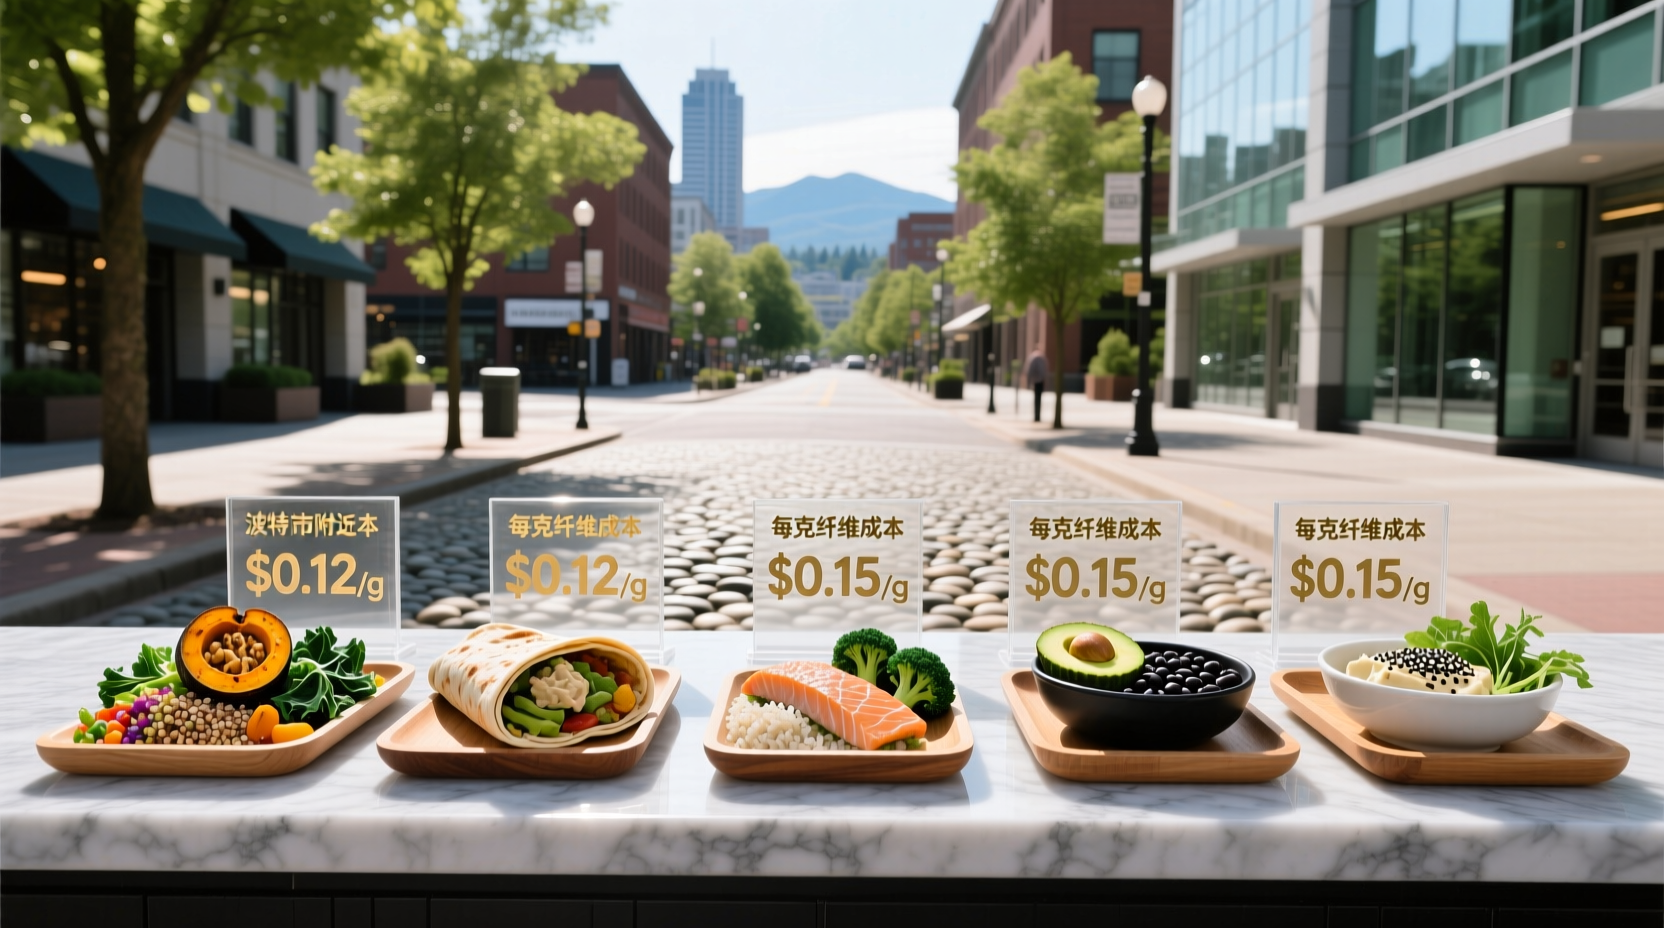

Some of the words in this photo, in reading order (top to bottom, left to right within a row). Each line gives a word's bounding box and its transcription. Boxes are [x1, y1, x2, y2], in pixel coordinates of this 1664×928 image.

[508, 513, 641, 538] 每克纤维成本
[771, 515, 904, 540] 每克纤维成本
[1029, 516, 1162, 541] 每克纤维成本
[1295, 517, 1426, 541] 每克纤维成本
[245, 549, 384, 602] $0.12/g
[505, 549, 647, 603] $0.12/g
[768, 552, 909, 604] $0.15/g
[1025, 553, 1166, 605] $0.15/g
[1290, 554, 1430, 605] $0.15/g
